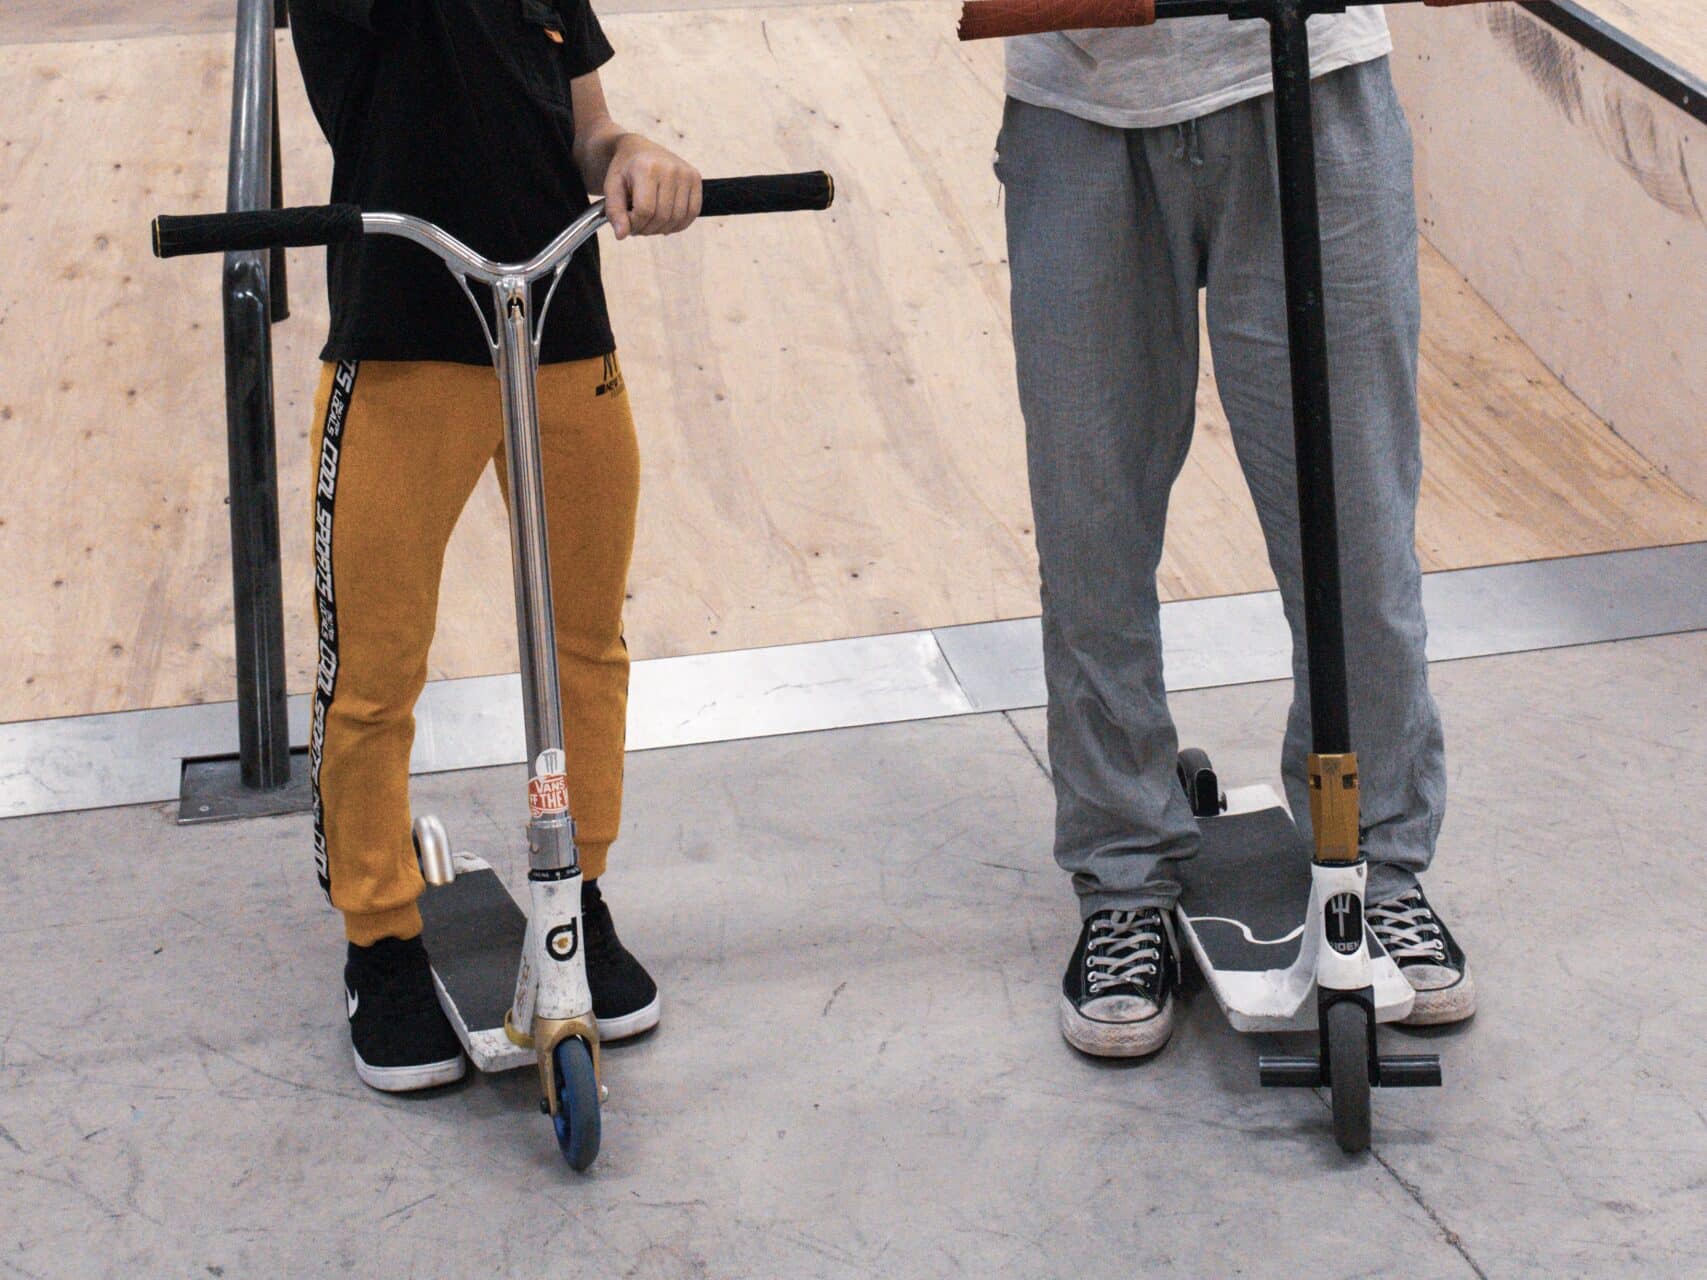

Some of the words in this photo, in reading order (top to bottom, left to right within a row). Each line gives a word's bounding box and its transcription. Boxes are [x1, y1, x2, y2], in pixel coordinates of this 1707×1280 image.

[318, 436, 338, 500] COOL
[315, 502, 334, 603] SPORTS
[535, 780, 566, 794] VANS
[540, 791, 563, 808] THE
